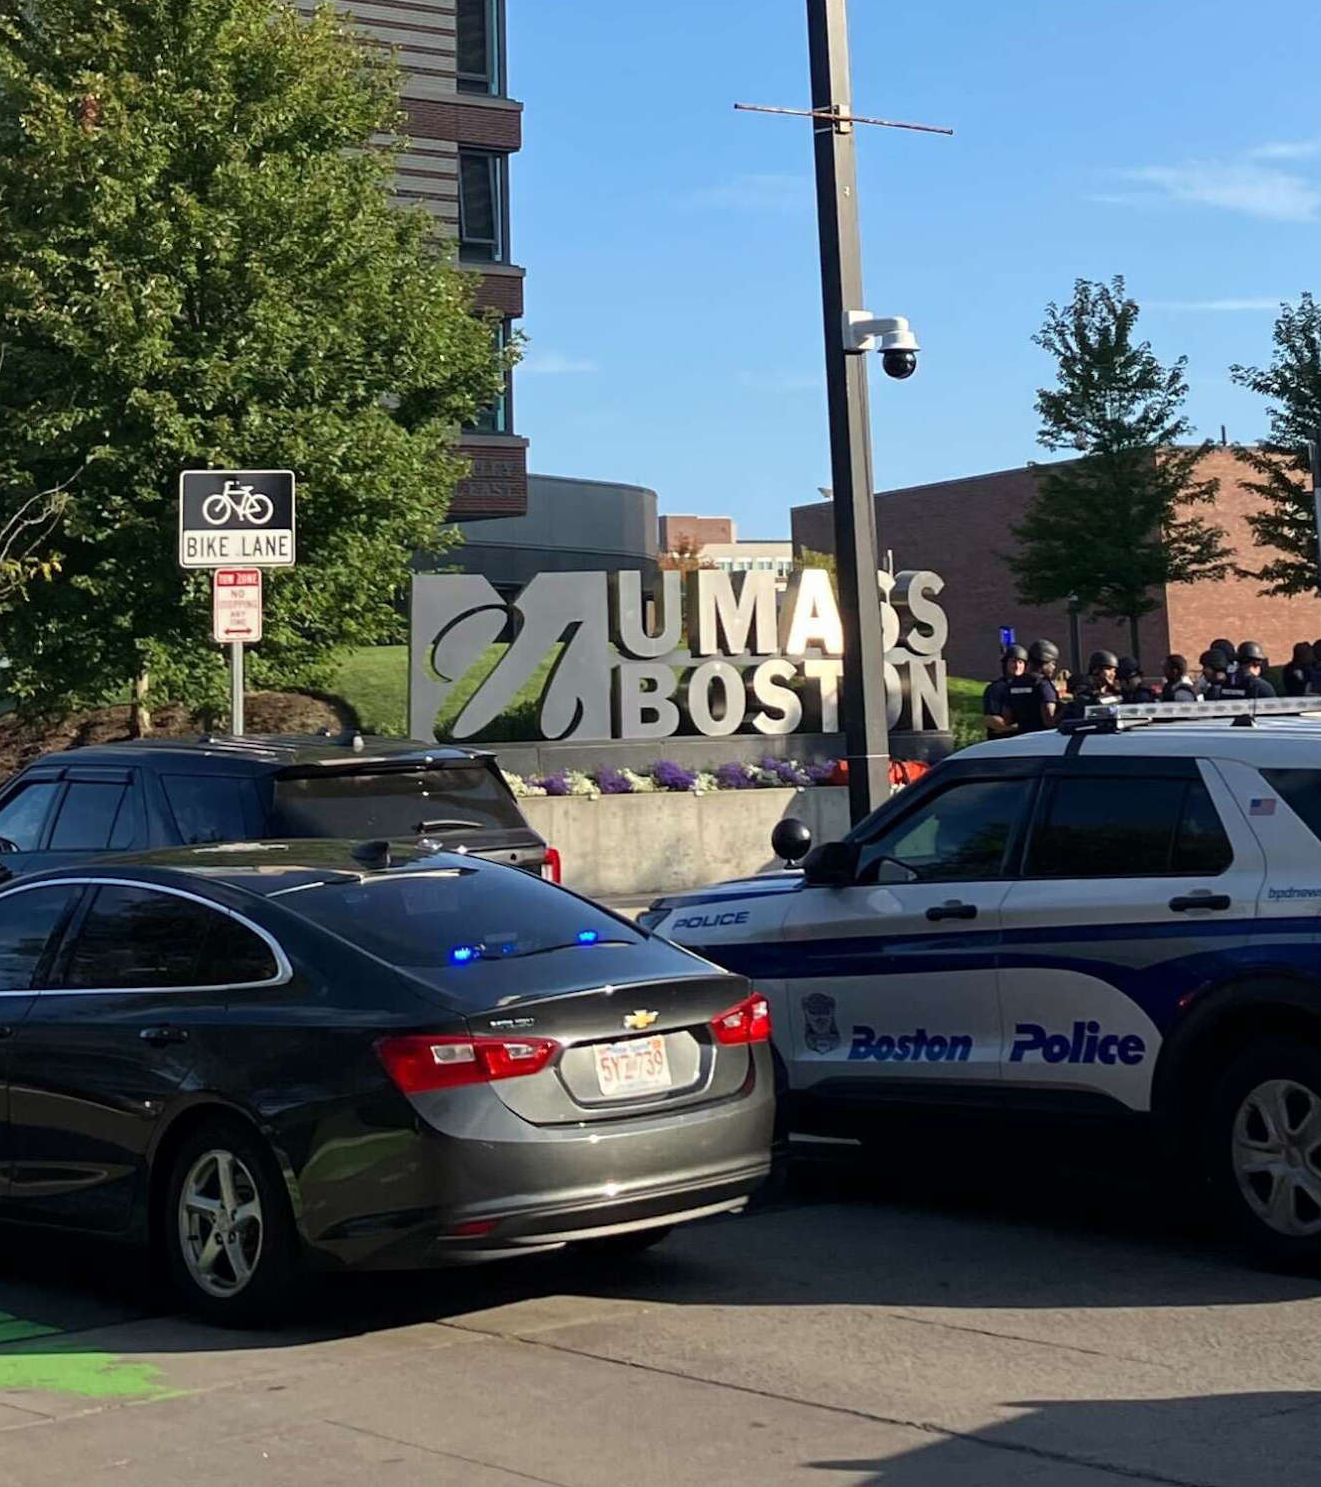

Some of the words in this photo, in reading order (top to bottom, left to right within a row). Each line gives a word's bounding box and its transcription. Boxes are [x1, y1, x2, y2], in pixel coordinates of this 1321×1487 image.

[186, 537, 229, 558] BIKE
[241, 536, 289, 557] LANE
[230, 589, 245, 599] NO
[671, 911, 751, 930] POLICE
[847, 1025, 974, 1063] Boston
[1009, 1020, 1146, 1065] Police
